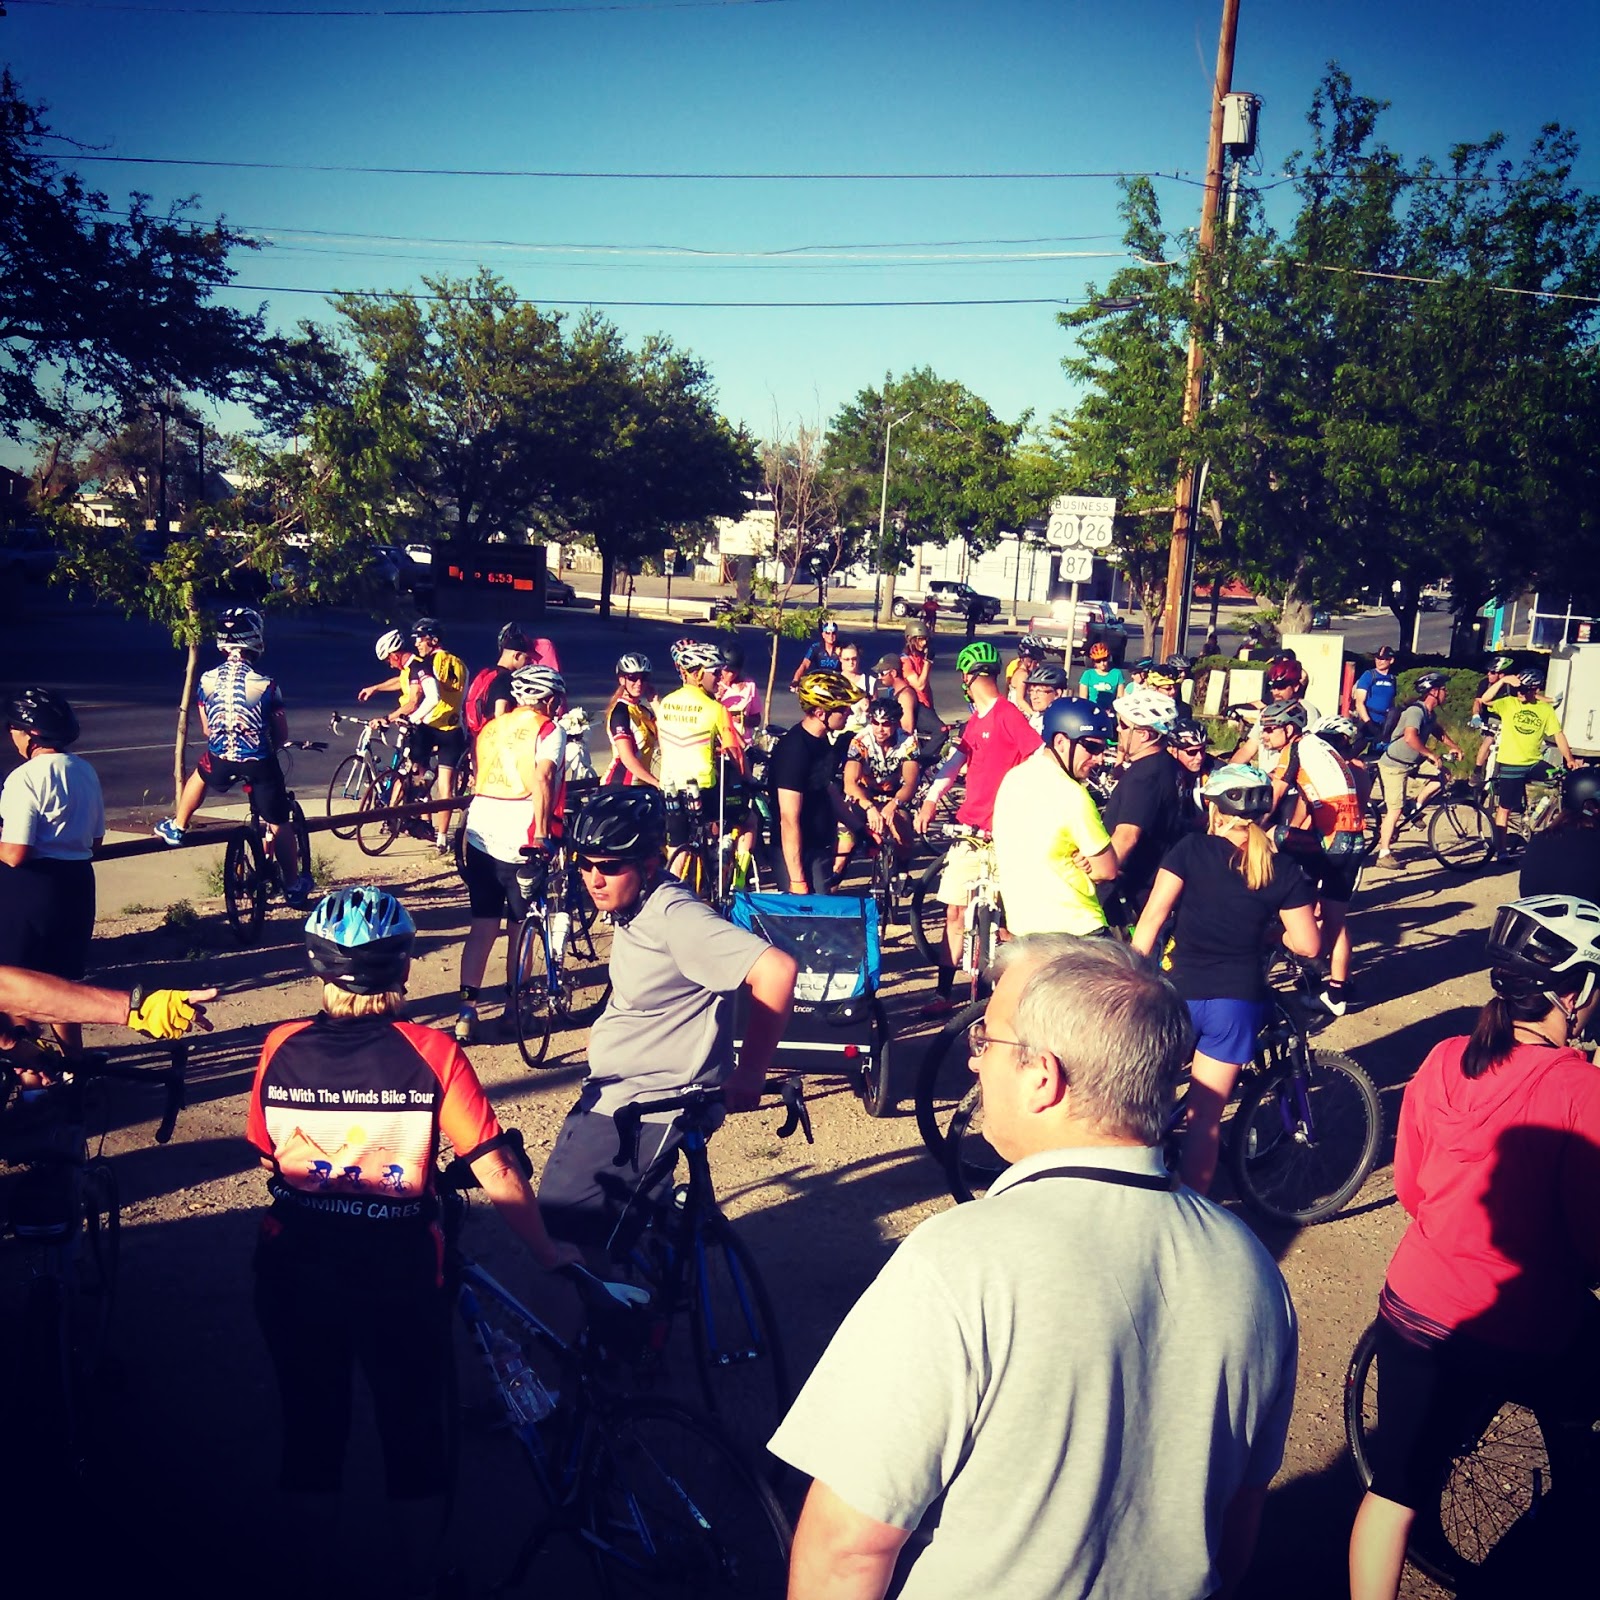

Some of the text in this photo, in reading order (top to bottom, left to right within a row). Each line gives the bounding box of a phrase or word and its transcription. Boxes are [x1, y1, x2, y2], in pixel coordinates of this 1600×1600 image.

[1055, 500, 1109, 512] BUSINESS
[1053, 521, 1074, 540] 20
[1085, 523, 1106, 541] 26
[1066, 556, 1087, 575] 87
[487, 572, 513, 583] 6:53
[267, 1085, 435, 1104] Ride With The Winds Bike Tour
[367, 1201, 421, 1219] CARES
